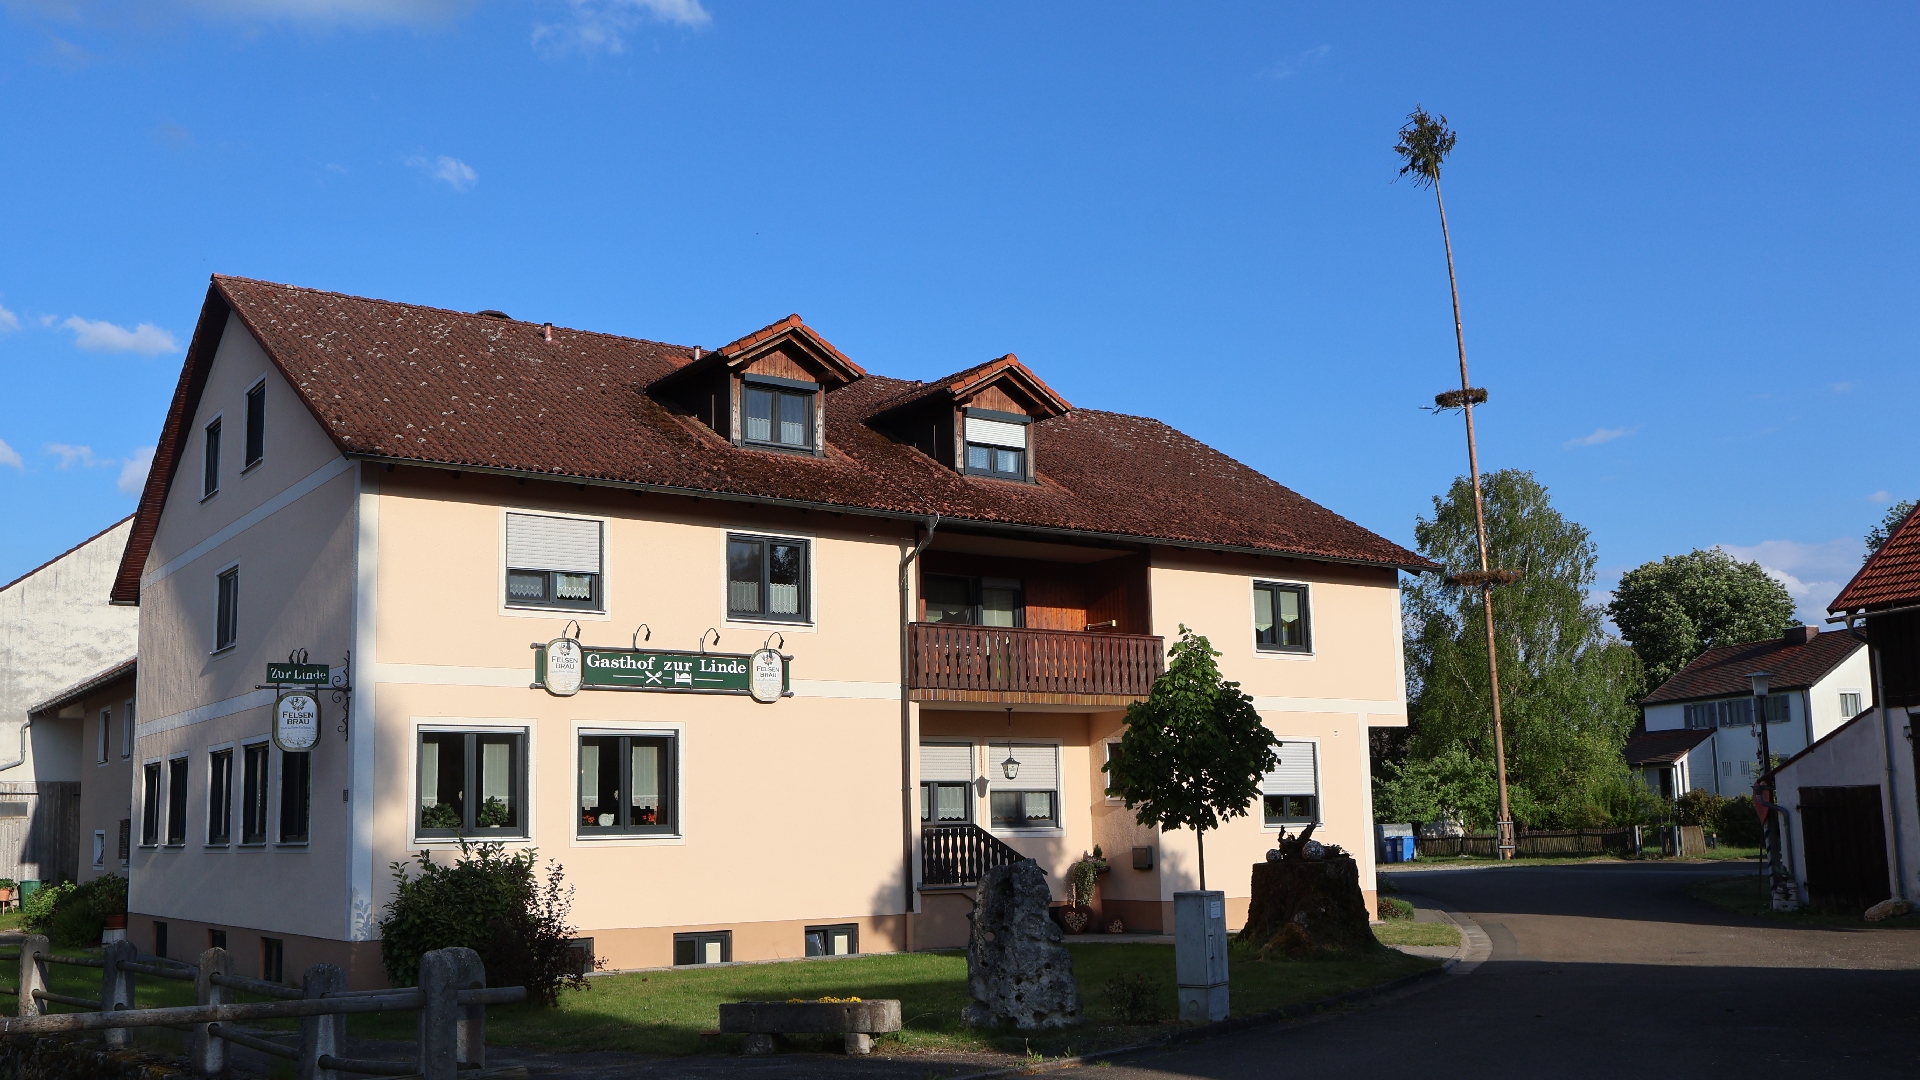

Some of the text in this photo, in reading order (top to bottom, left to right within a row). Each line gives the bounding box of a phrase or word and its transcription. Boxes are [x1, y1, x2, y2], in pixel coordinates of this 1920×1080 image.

[551, 655, 579, 664] FELSEN
[586, 653, 747, 674] Gasthof zur Linde
[270, 667, 327, 681] Zur Linde
[282, 710, 314, 719] FELSEN
